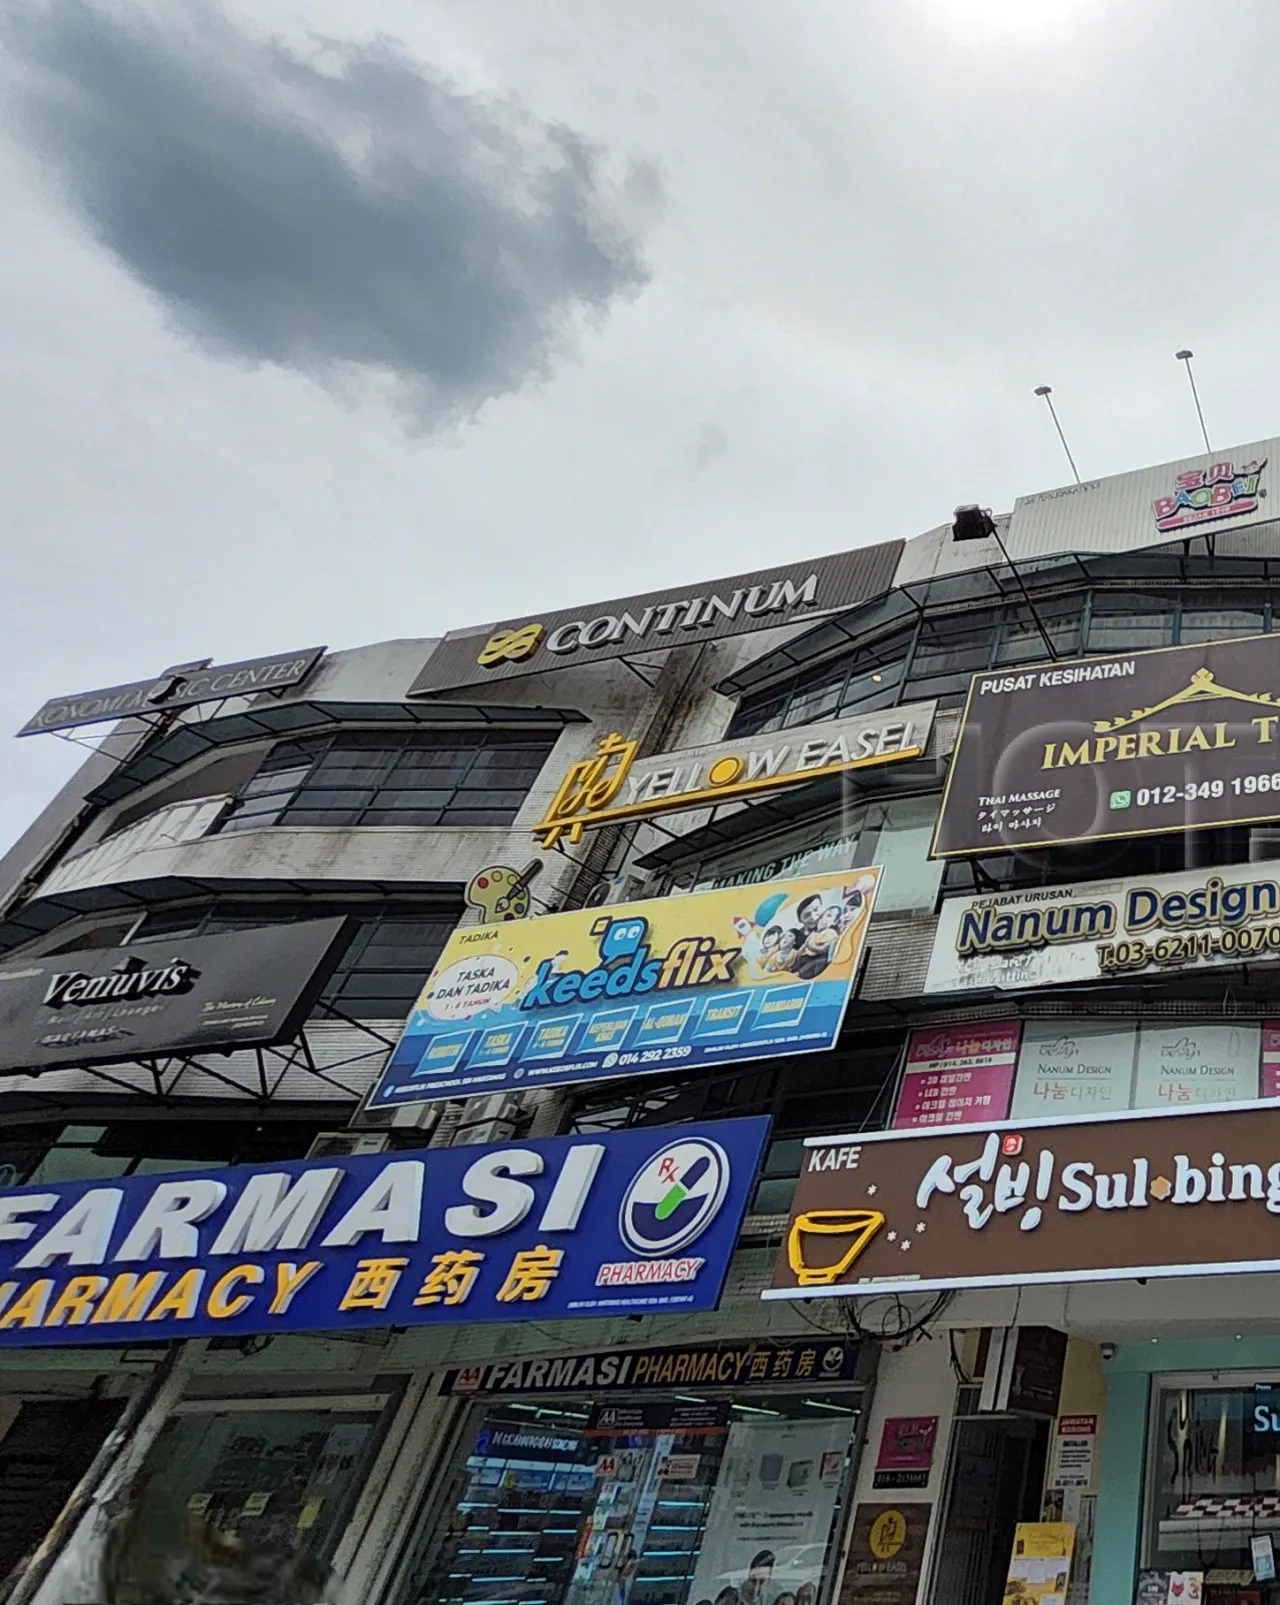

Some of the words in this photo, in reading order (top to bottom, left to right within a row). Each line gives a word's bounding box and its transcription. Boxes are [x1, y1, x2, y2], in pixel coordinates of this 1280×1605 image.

[1175, 461, 1235, 491] 宝贝
[1152, 473, 1260, 520] BAOBEI
[545, 572, 820, 656] CONTINUM
[127, 676, 210, 709] MSIC
[210, 658, 308, 692] CENTER
[979, 672, 1037, 697] PUSAT
[1038, 660, 1136, 690] KESIHATAN
[1039, 721, 1237, 771] IMPERIAL
[624, 744, 790, 806] YELLOW
[793, 719, 920, 773] EASEL
[978, 794, 1006, 807] THAI
[1008, 788, 1062, 804] MASSAGE
[1135, 777, 1224, 807] 012-349
[971, 893, 1024, 910] PEJABAT
[1024, 888, 1073, 906] URUSAN
[459, 930, 500, 945] TADIKA
[957, 899, 1116, 952] Nanum
[435, 984, 464, 1000] DAN
[464, 978, 511, 997] TADIKA
[457, 966, 496, 983] TASKA
[617, 1050, 640, 1067] 014
[639, 1047, 661, 1064] 292
[661, 1044, 692, 1061] 2359
[807, 1144, 862, 1174] KAFE
[0, 1143, 607, 1269] FARMASI
[338, 1245, 565, 1312] 西药房
[596, 1258, 704, 1286] PHARMACY
[485, 1354, 632, 1390] FARMASI
[632, 1350, 748, 1385] PHARMACY
[748, 1348, 816, 1379] 西药房
